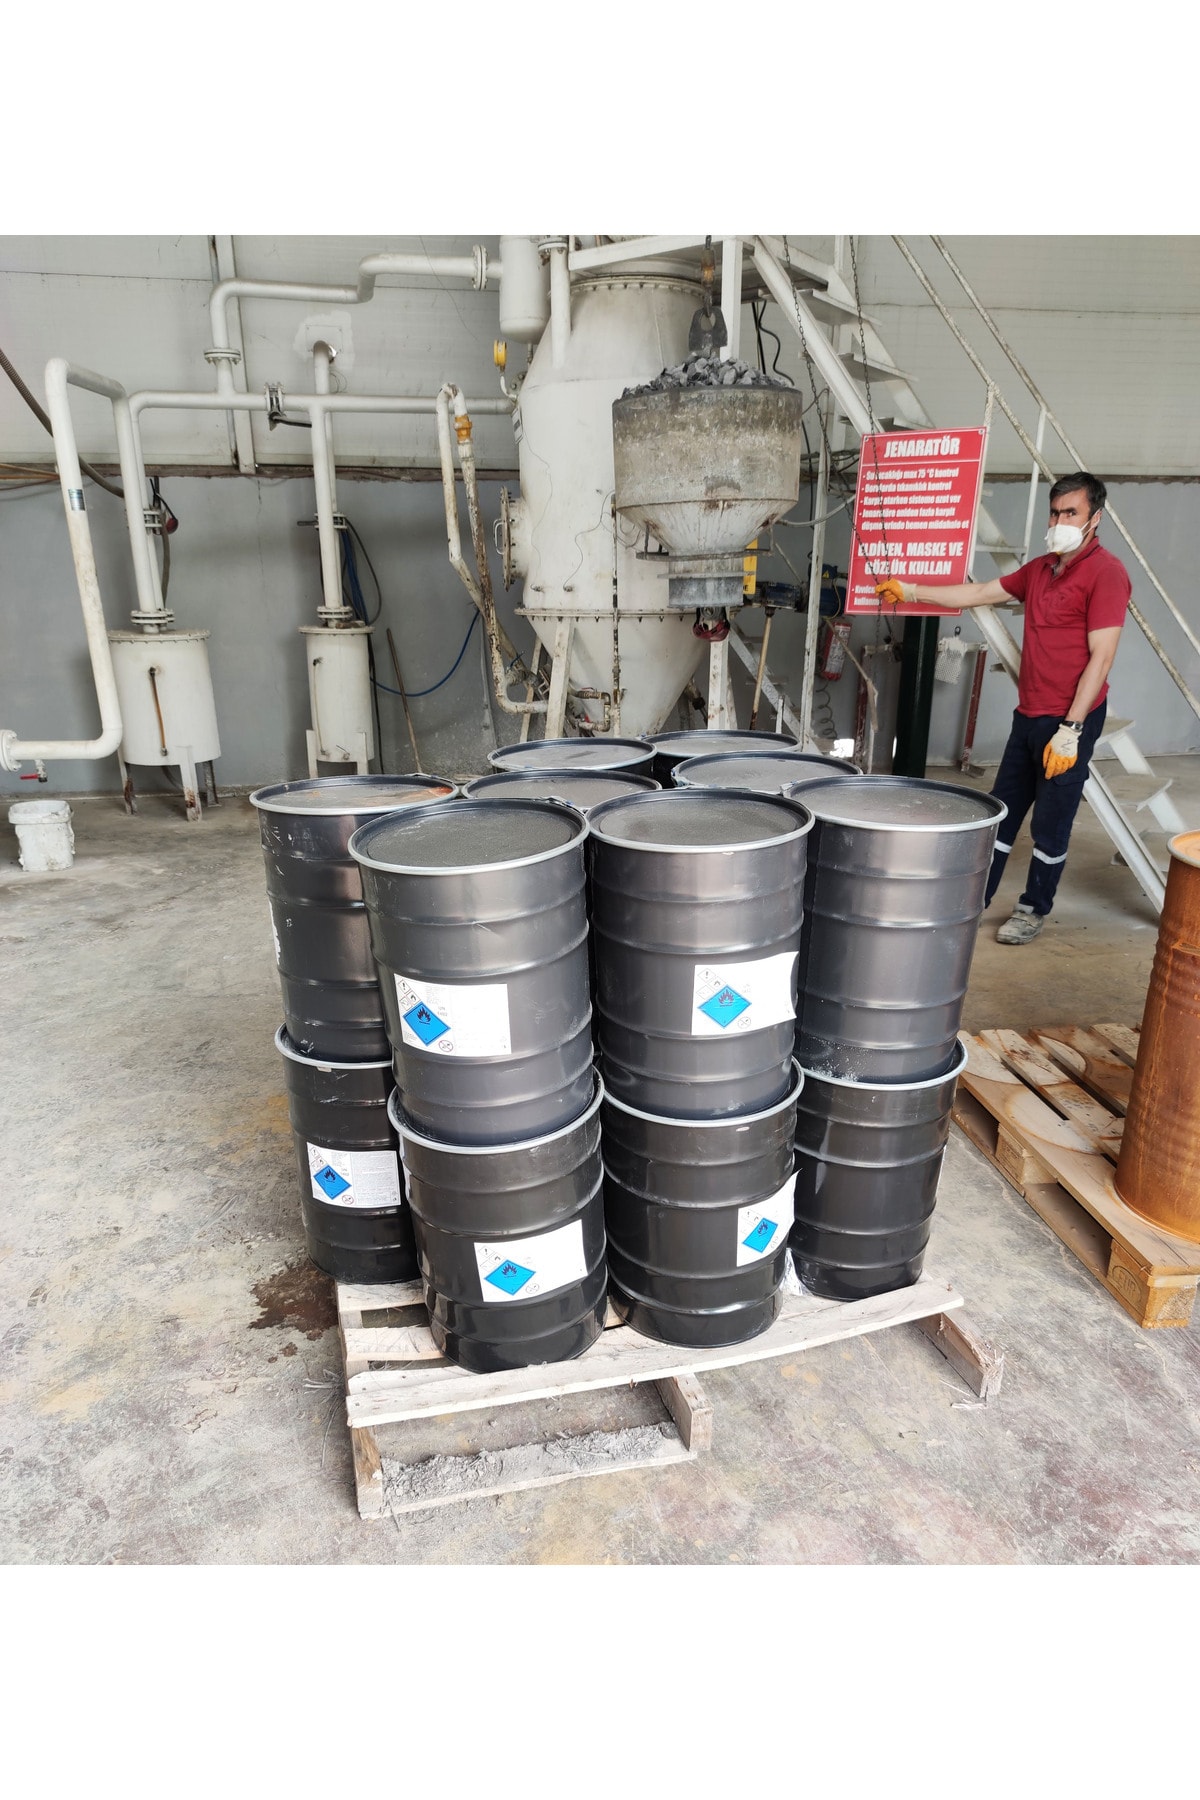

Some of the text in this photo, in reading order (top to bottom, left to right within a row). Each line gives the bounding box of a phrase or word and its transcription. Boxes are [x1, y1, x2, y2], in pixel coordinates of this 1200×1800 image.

[884, 435, 960, 458] JENARATÖR
[917, 469, 926, 478] 75
[934, 467, 959, 477] kontrol
[927, 480, 952, 491] kontrol
[908, 494, 935, 504] sisteme
[949, 494, 961, 503] ver
[862, 521, 905, 532] düşmeerinde
[906, 542, 947, 557] MASKE
[948, 542, 964, 557] VE
[908, 560, 952, 576] KULLAN
